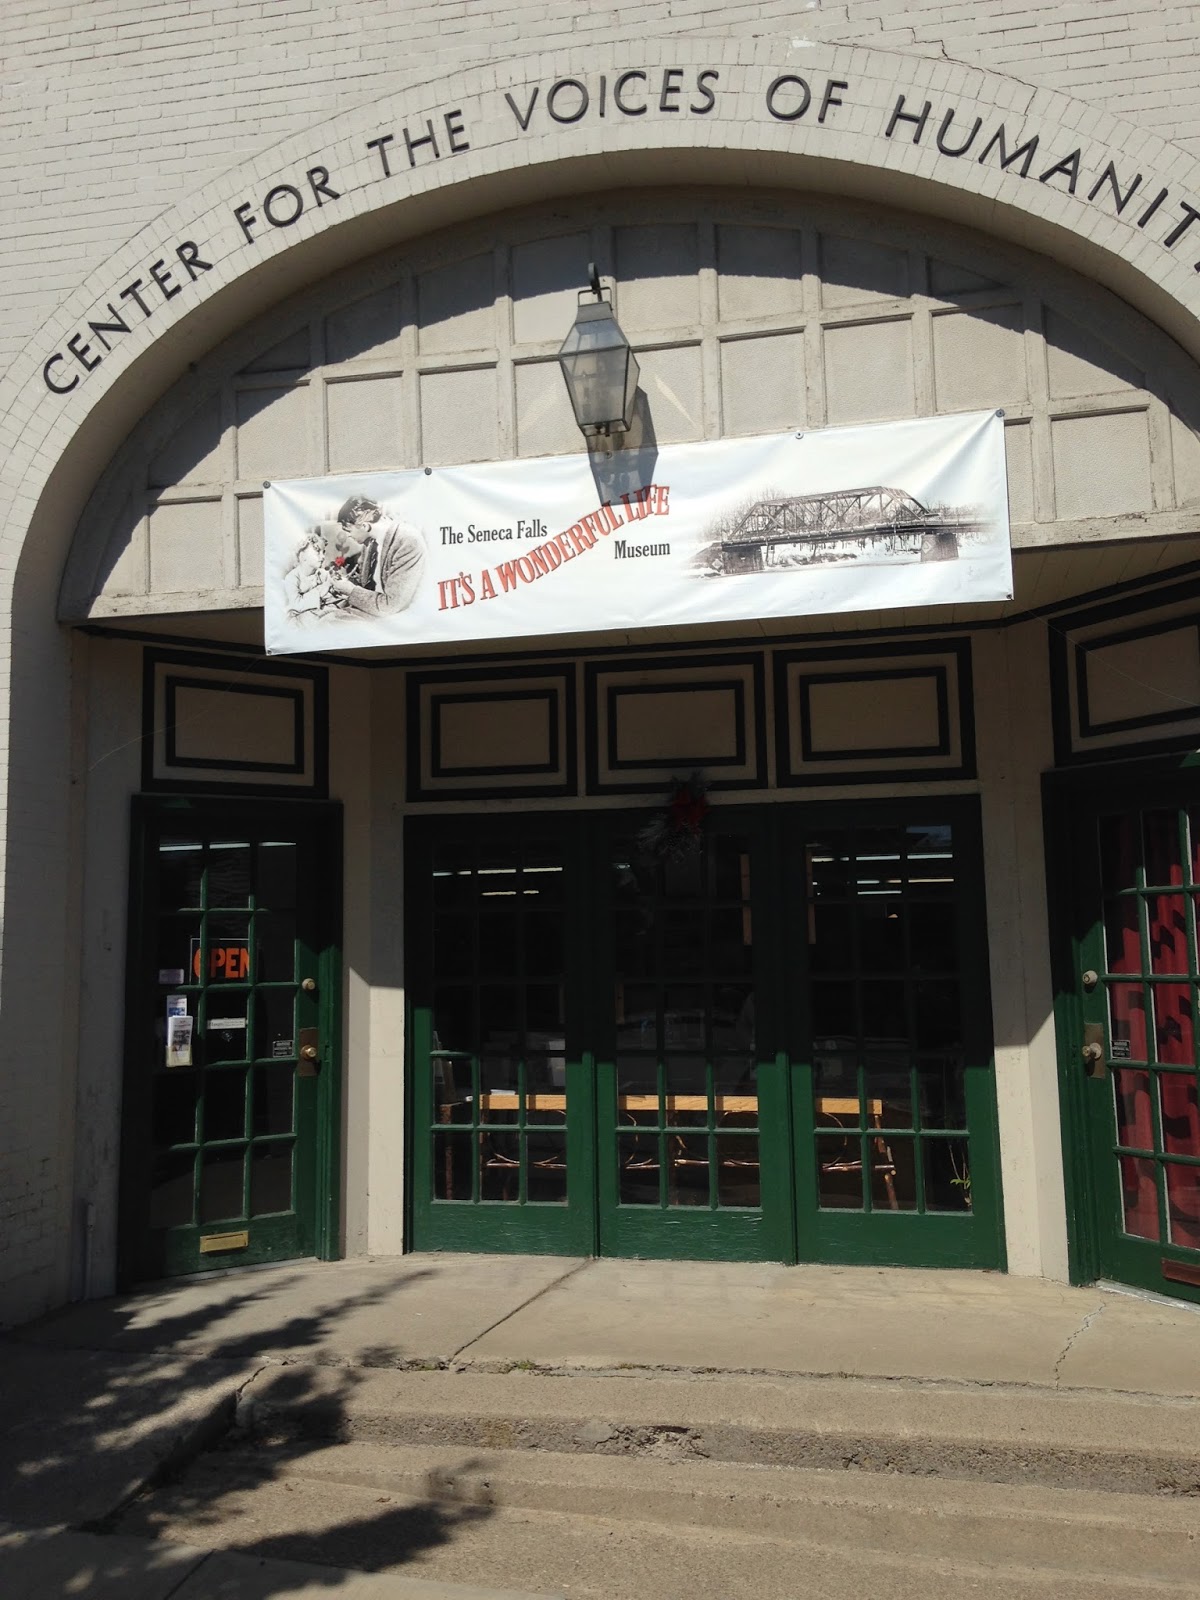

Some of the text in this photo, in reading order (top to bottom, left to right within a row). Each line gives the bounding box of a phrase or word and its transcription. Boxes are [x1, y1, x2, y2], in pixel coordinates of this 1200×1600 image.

[42, 67, 1200, 395] CENTER FOR THE VOICES OF HUMANIT
[437, 484, 671, 611] IT'S A WONDERFUL LIFE
[439, 518, 548, 545] The Seneca Falls
[613, 539, 671, 560] Museum
